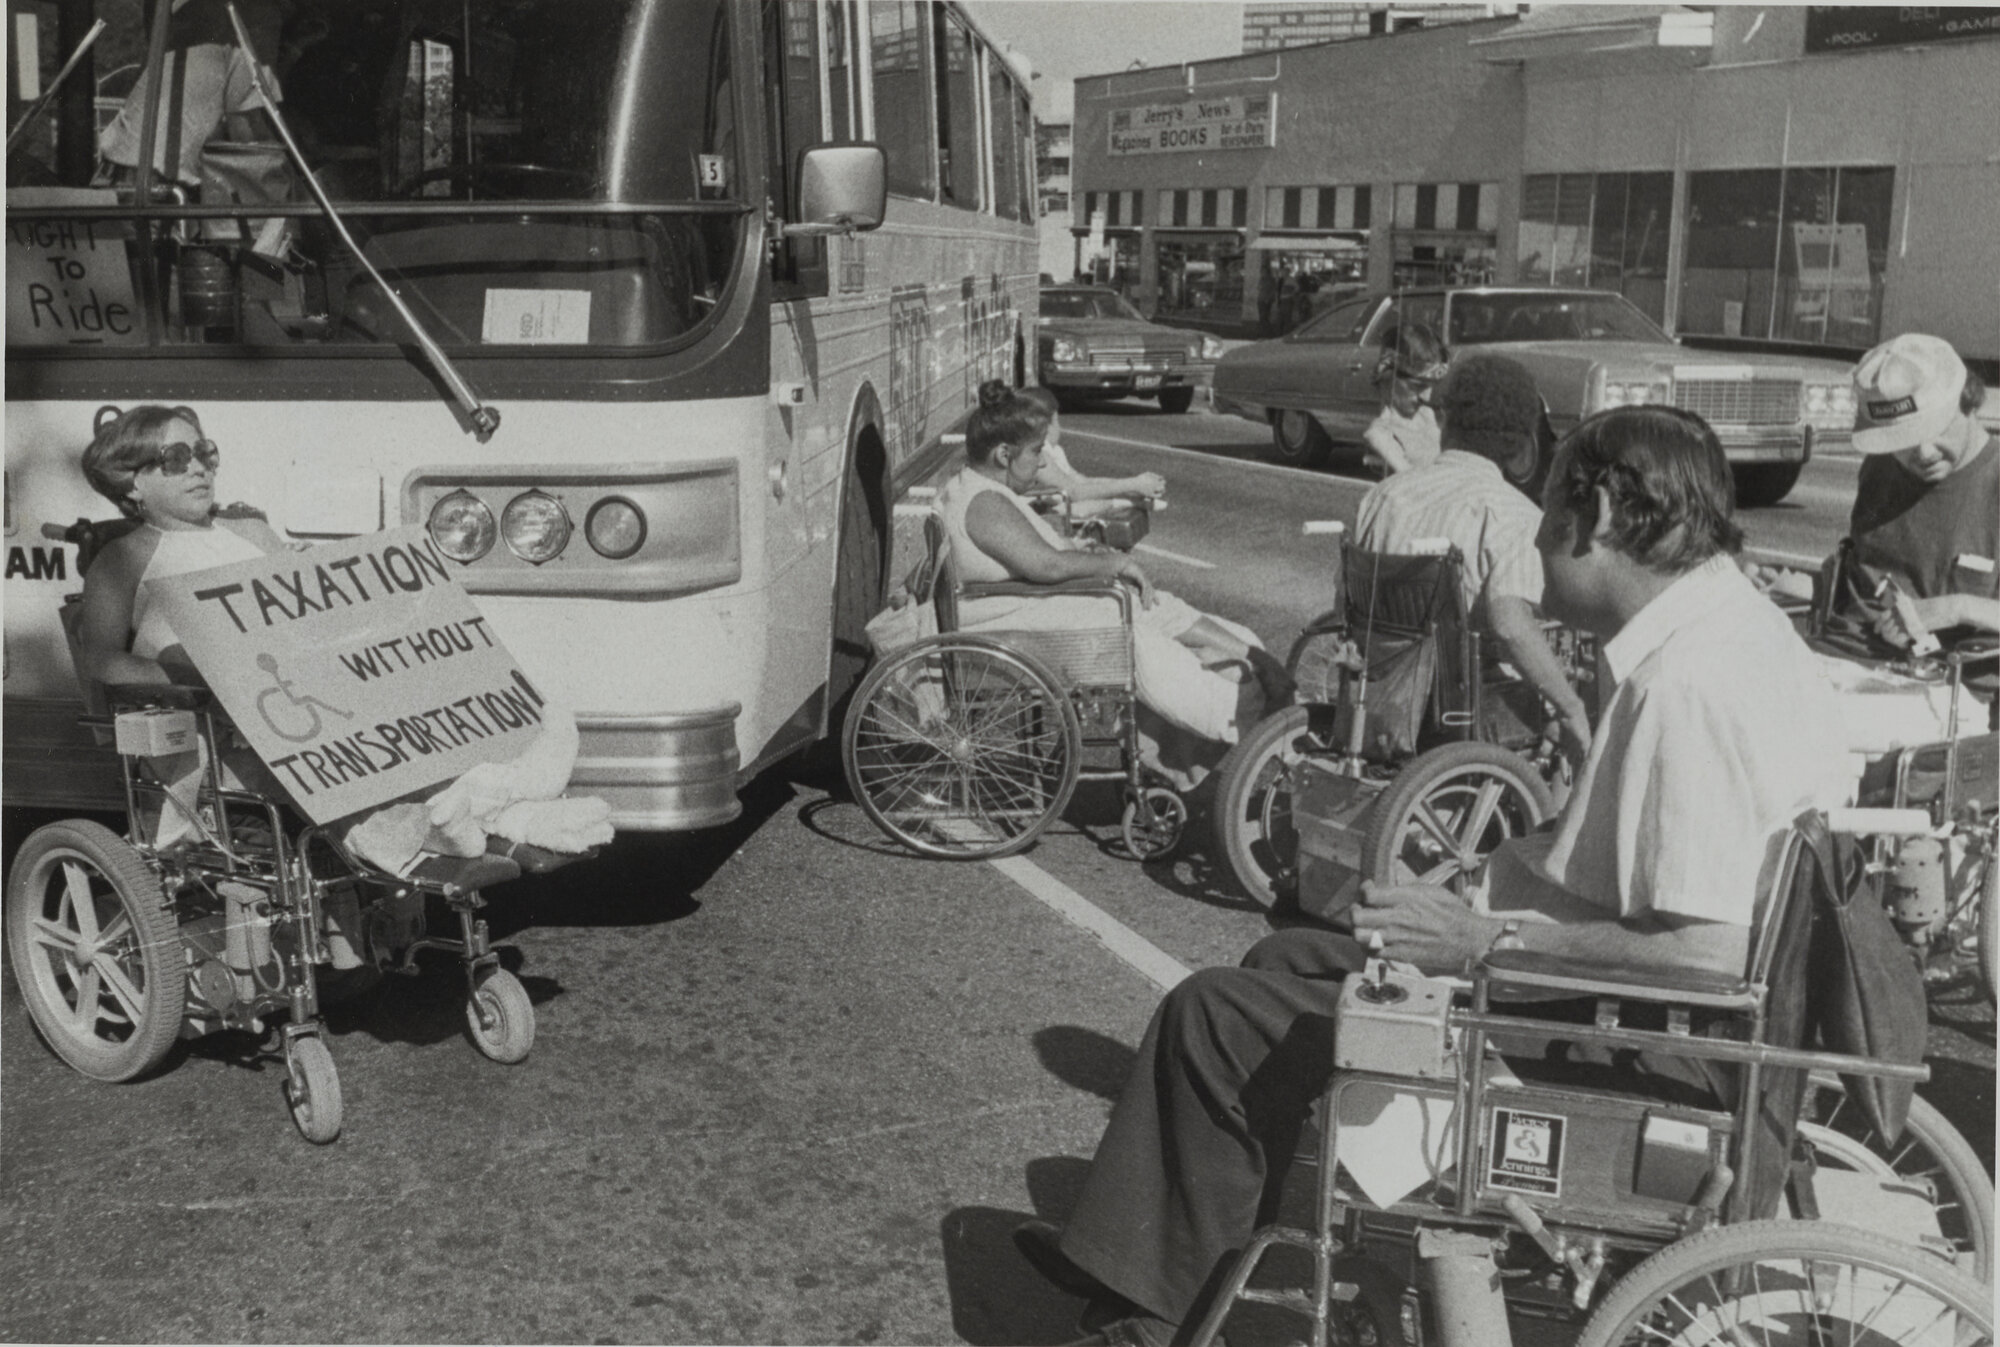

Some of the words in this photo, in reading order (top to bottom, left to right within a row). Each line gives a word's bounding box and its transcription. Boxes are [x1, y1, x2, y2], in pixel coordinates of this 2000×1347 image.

[1144, 106, 1184, 127] Jerry's
[1197, 103, 1231, 119] News
[1160, 127, 1207, 148] BOOKS
[29, 283, 132, 335] Ride
[5, 546, 66, 580] AM
[194, 538, 451, 634] TAXATION
[338, 616, 494, 682] WITHOUT
[1500, 1158, 1551, 1177] Jennings
